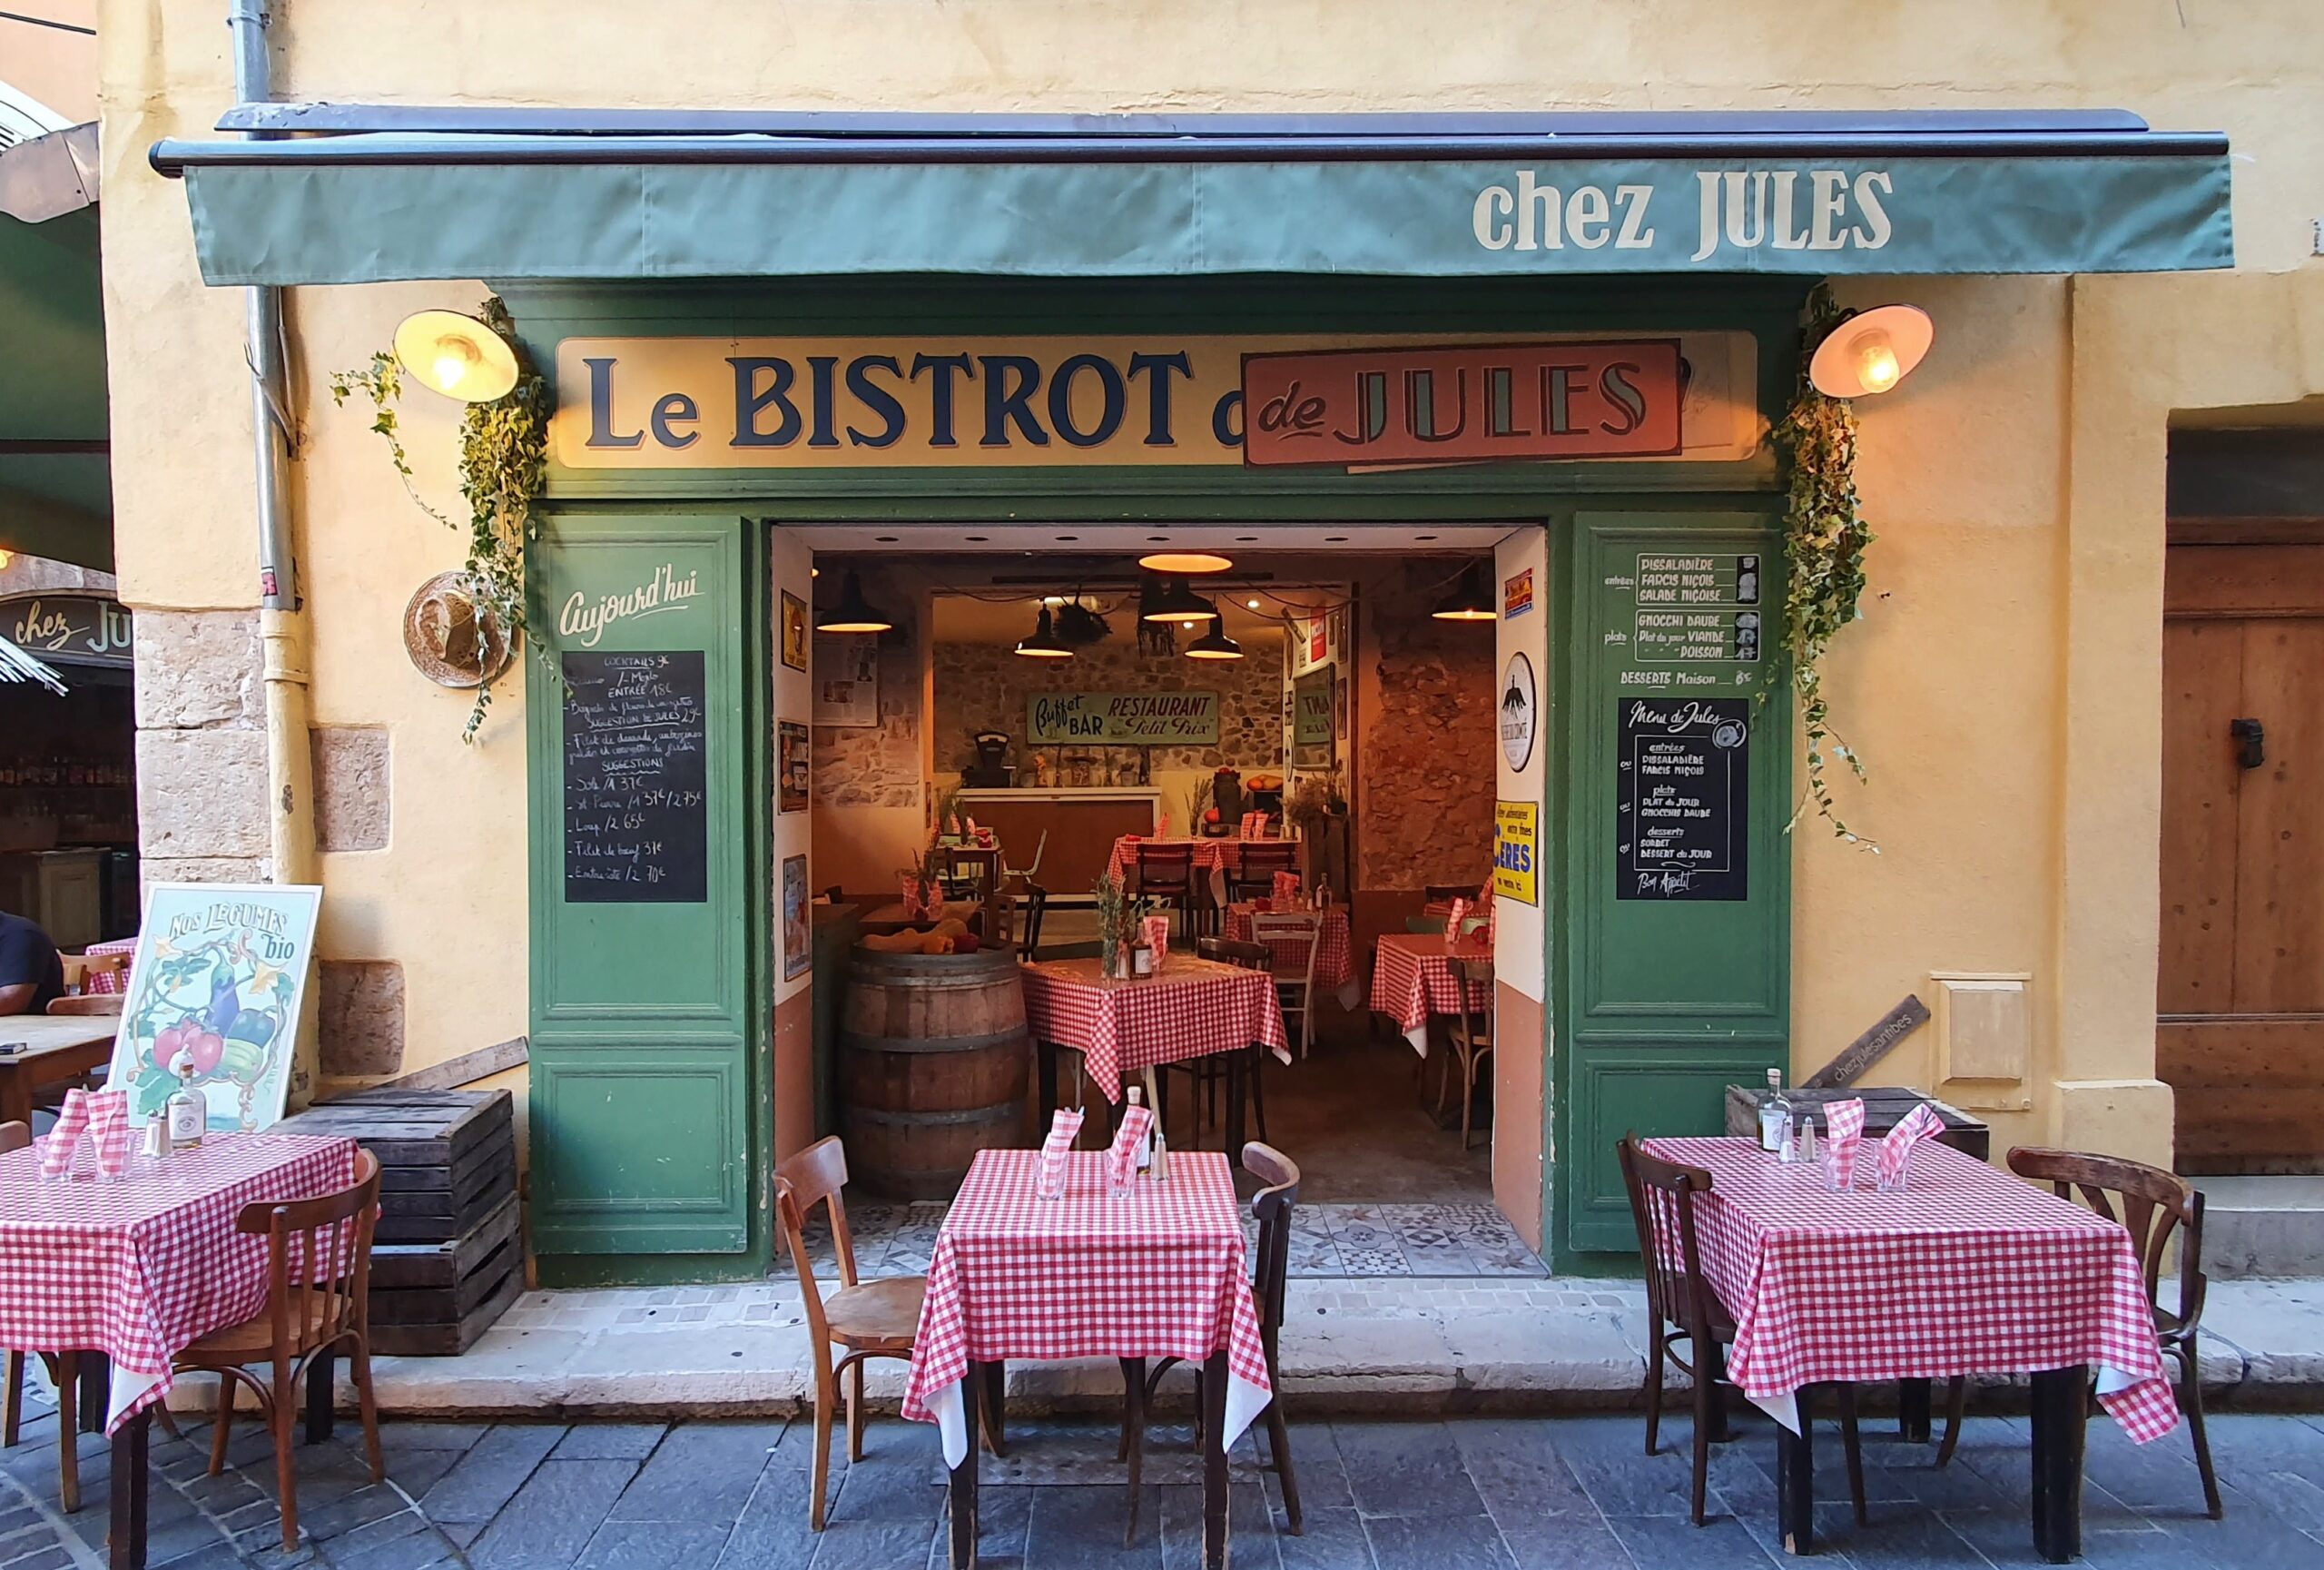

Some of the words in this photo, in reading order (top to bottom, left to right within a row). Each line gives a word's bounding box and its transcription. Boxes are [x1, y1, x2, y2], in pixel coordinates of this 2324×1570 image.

[1472, 170, 1655, 251] chez
[1690, 171, 1894, 262] JULES
[583, 358, 700, 449] Le
[724, 351, 1195, 449] BISTROT
[1258, 380, 1326, 439] de
[1333, 361, 1647, 445] JULES
[1641, 574, 1679, 587] FARCIS
[1640, 589, 1677, 602] SALADE
[15, 600, 90, 651] chez
[1639, 615, 1683, 627] GNOCCHI
[1687, 615, 1720, 627] DAUBE
[1688, 630, 1725, 643] VIANDE
[1680, 646, 1723, 658] POISSON
[1620, 671, 1671, 685] DESSERTS
[1676, 672, 1716, 685] Maison
[1108, 696, 1211, 716] RESTAURANT
[1628, 700, 1668, 727] Menu
[1035, 694, 1085, 736] Buffet
[1069, 714, 1103, 736] BAR
[1667, 702, 1727, 733] Jules
[1670, 709, 1684, 724] de
[1642, 798, 1663, 806] PLAT
[1677, 798, 1700, 806] JOUR
[1647, 825, 1685, 836] desserts
[1640, 849, 1674, 859] DESSERT
[1689, 849, 1712, 859] JOUR
[1637, 873, 1658, 895] Bon
[261, 933, 295, 960] bio
